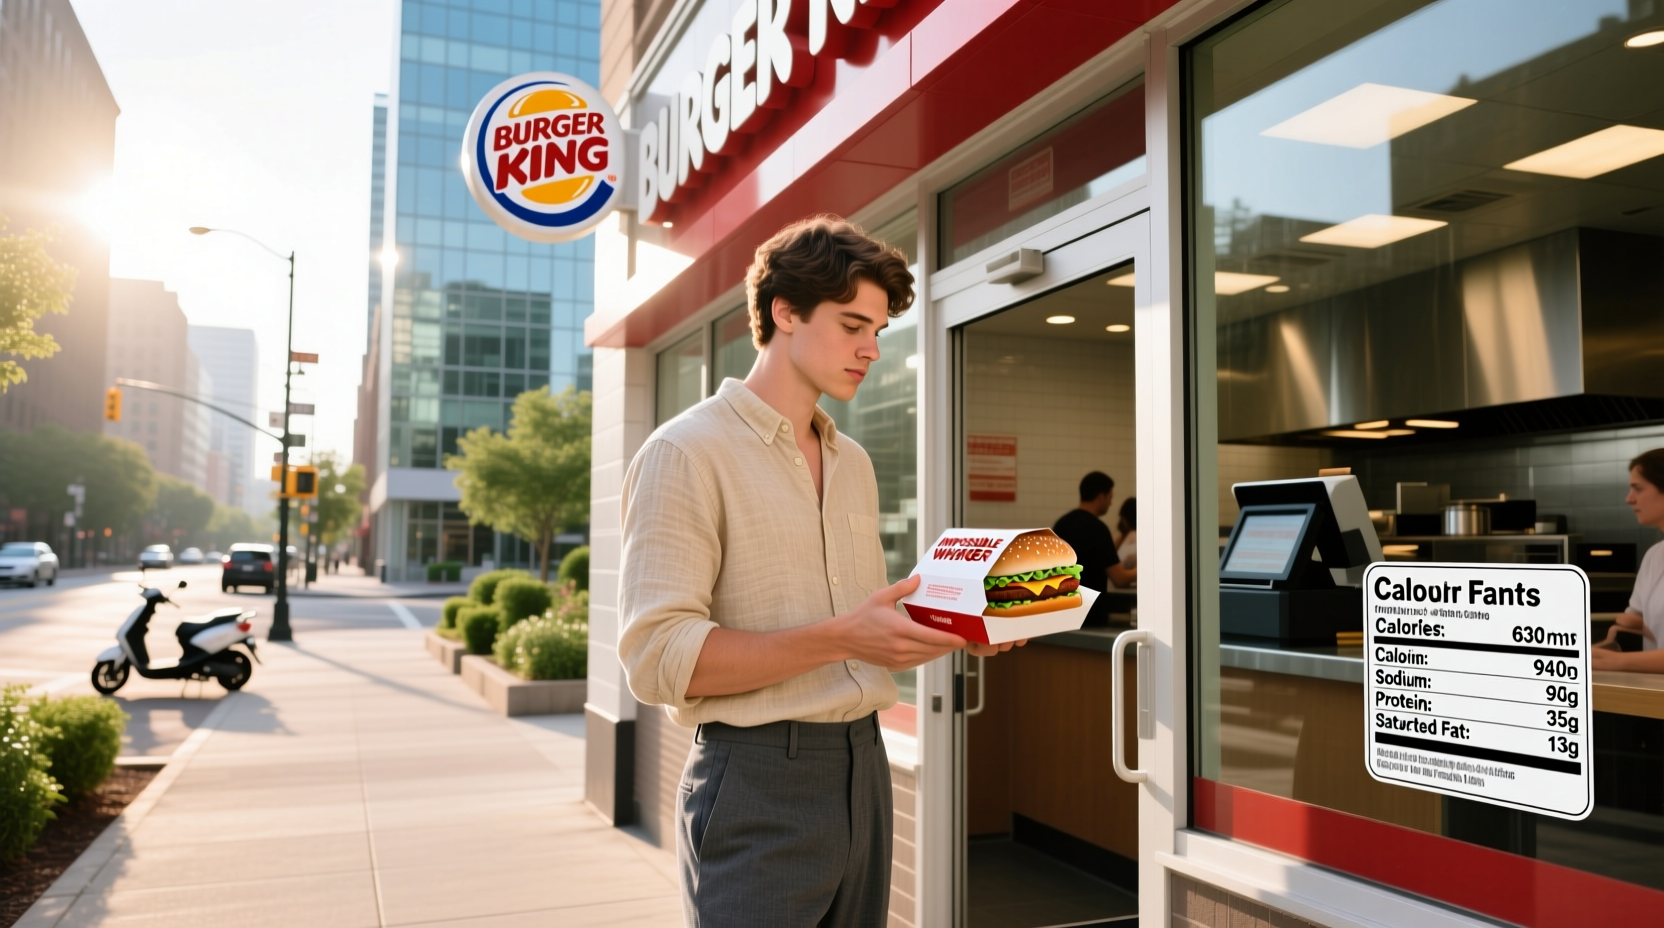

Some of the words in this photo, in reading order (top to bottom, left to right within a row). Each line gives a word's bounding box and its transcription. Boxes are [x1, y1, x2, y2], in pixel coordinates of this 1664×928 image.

[494, 112, 605, 152] BURGER
[637, 0, 793, 225] BURGER
[496, 136, 609, 191] KING
[1469, 579, 1541, 607] Fants
[1375, 617, 1445, 638] Calories:
[1375, 668, 1431, 689] Sodium:
[1545, 684, 1579, 709] 90g
[1375, 690, 1432, 712] Protein:
[1546, 709, 1579, 734] 35g
[1441, 720, 1470, 740] Fat:
[1548, 735, 1579, 759] 13g
